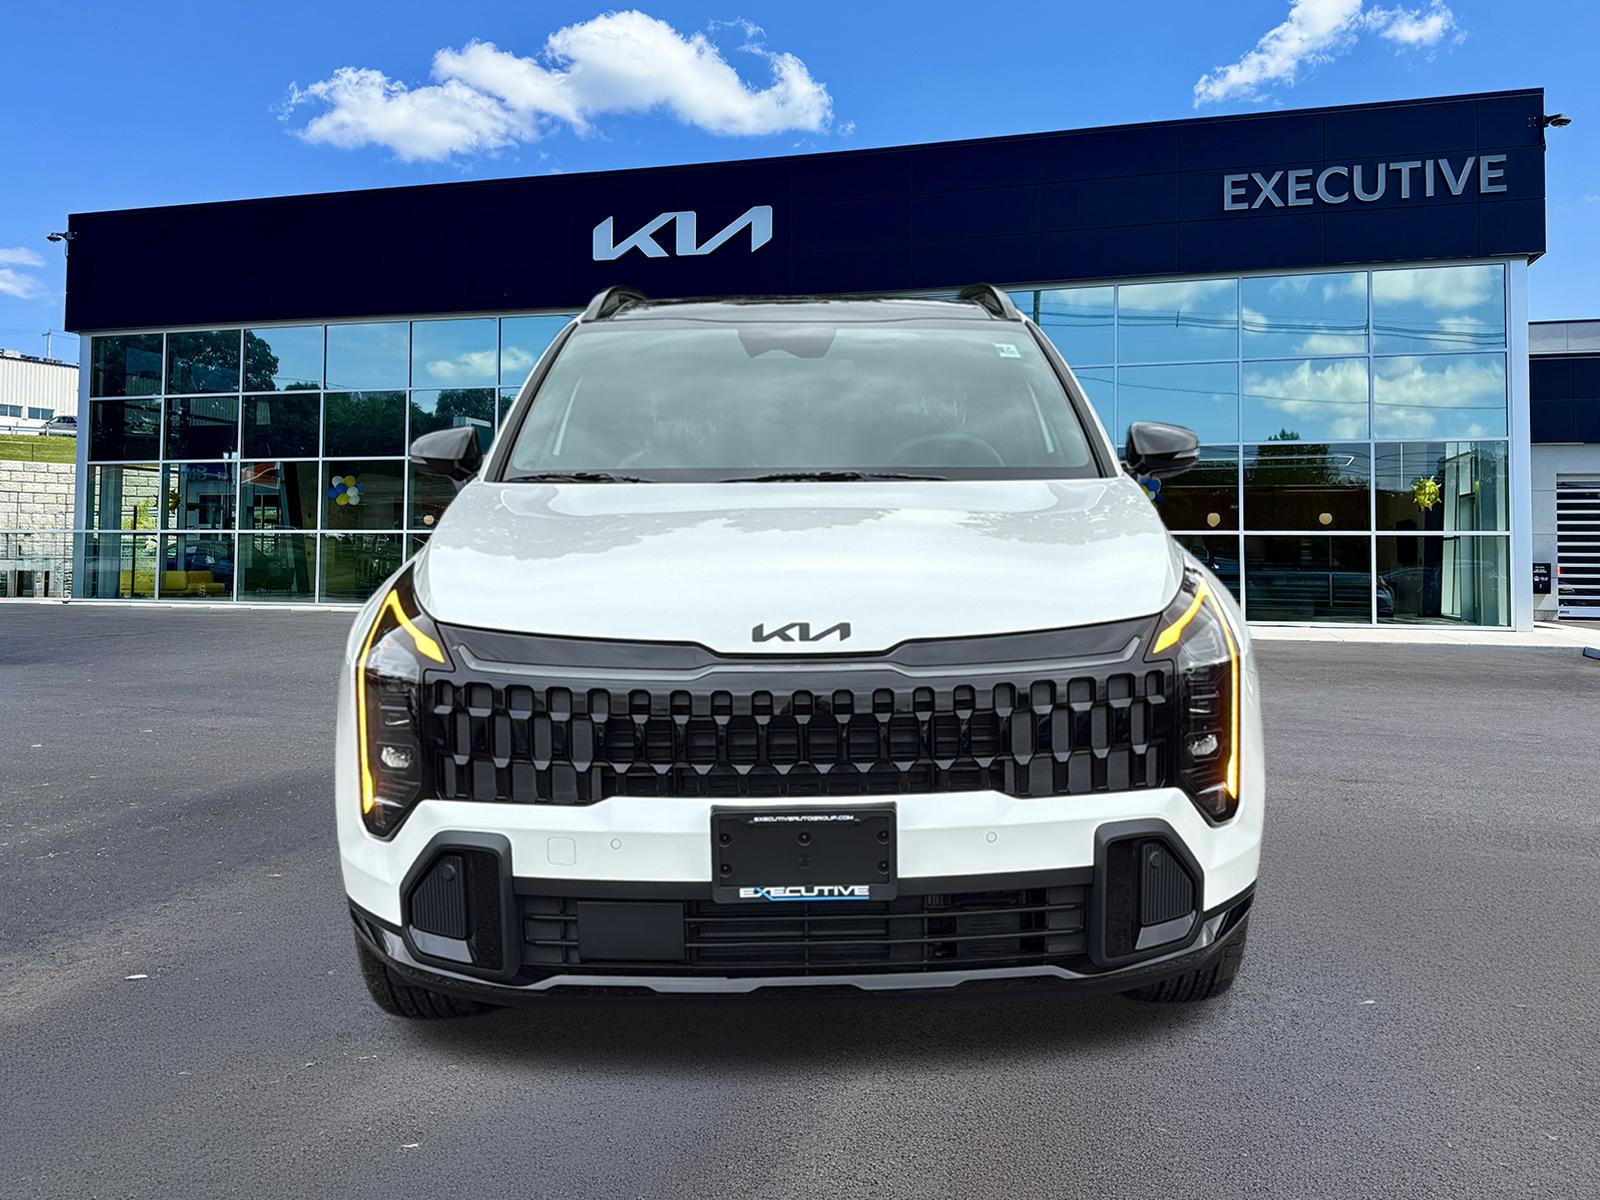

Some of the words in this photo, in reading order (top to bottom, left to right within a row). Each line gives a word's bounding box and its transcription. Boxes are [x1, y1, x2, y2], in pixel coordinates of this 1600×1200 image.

[1223, 154, 1508, 211] EXECUTIVE
[593, 205, 772, 261] KIA
[752, 622, 851, 642] KIA
[753, 815, 854, 823] EXECUTIVEAUTOGROUP.COM
[739, 885, 870, 900] EXECUTIVE
